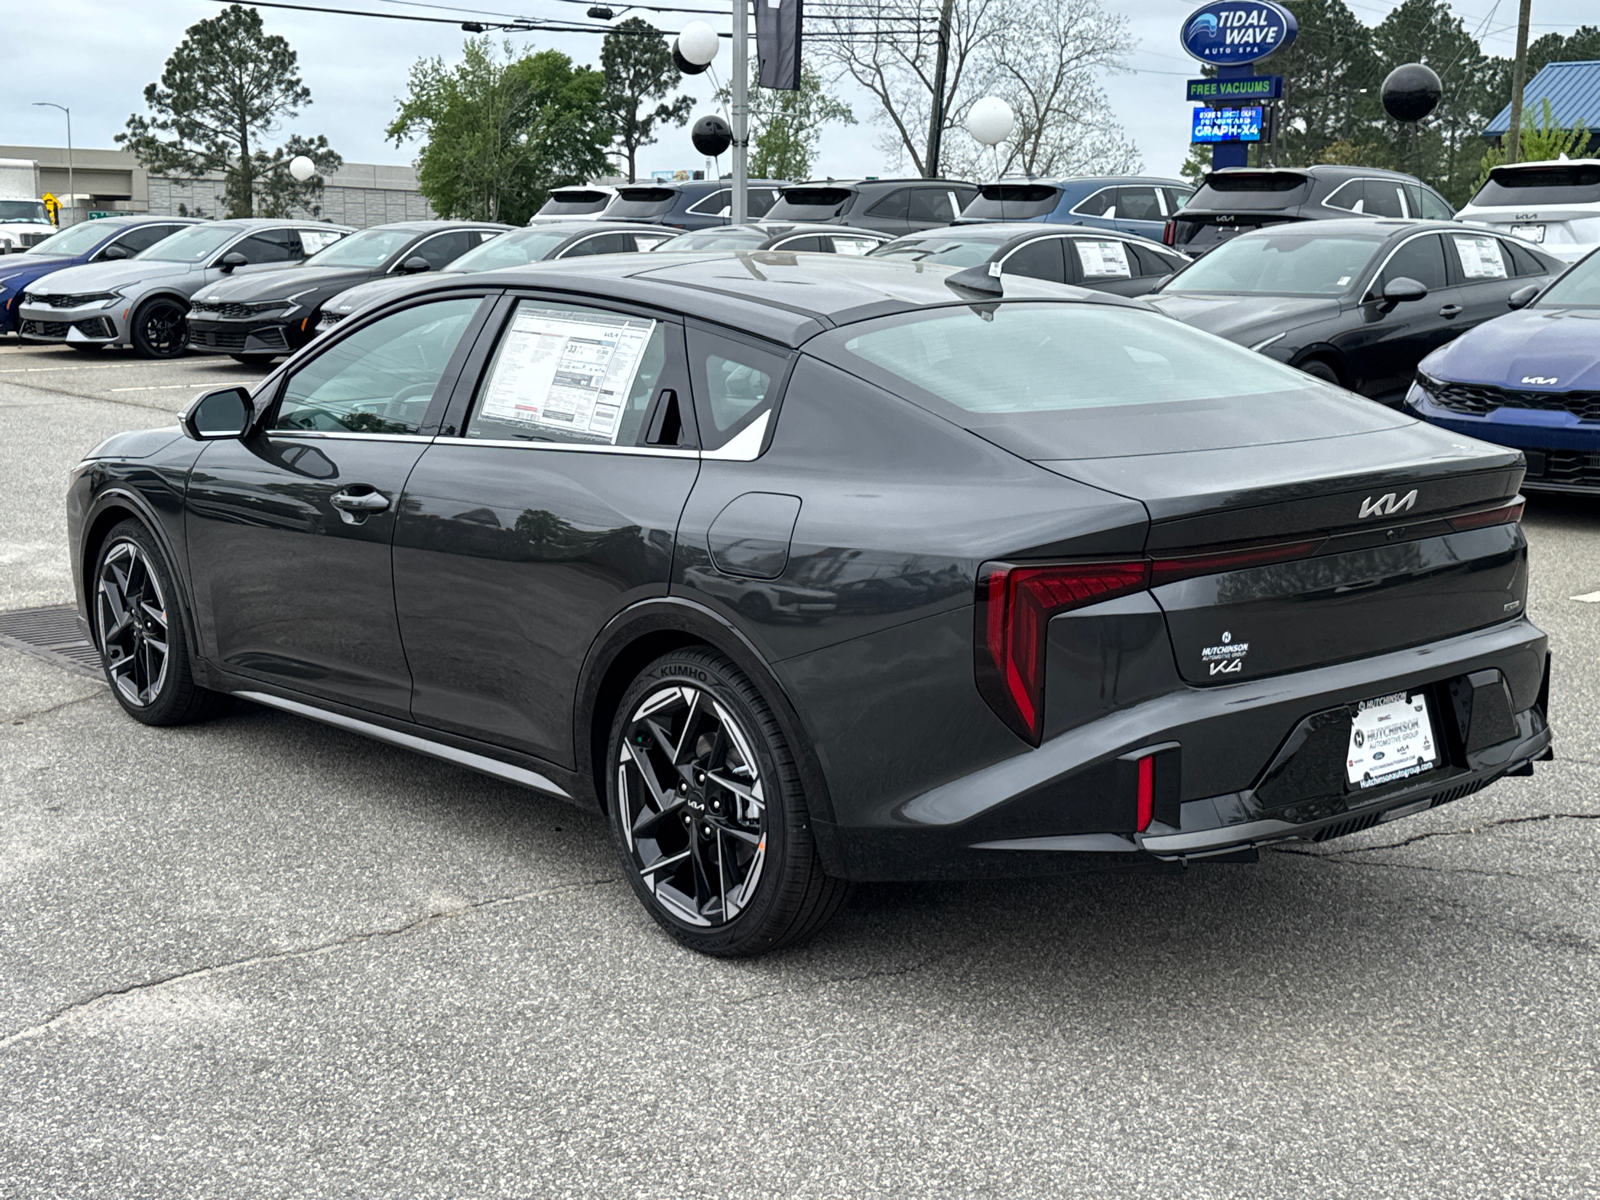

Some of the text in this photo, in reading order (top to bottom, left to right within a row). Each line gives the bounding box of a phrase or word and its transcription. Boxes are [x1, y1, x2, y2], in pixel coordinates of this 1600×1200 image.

[1219, 9, 1268, 27] TIDAL
[1225, 26, 1278, 45] WAVE
[1238, 46, 1259, 54] SPA
[1190, 80, 1270, 95] FREE VACUUMS
[1194, 124, 1259, 137] GRAPH-X4
[1358, 489, 1418, 518] KIA
[1201, 643, 1249, 656] HUTCHINSON
[660, 665, 708, 682] KUMHO
[1366, 691, 1407, 709] HUTCHINSON
[1377, 714, 1392, 722] GMC
[1366, 719, 1420, 742] HUTCHINSON
[1368, 730, 1419, 750] AUTOMOTIVE GROUP
[687, 798, 705, 811] KIA
